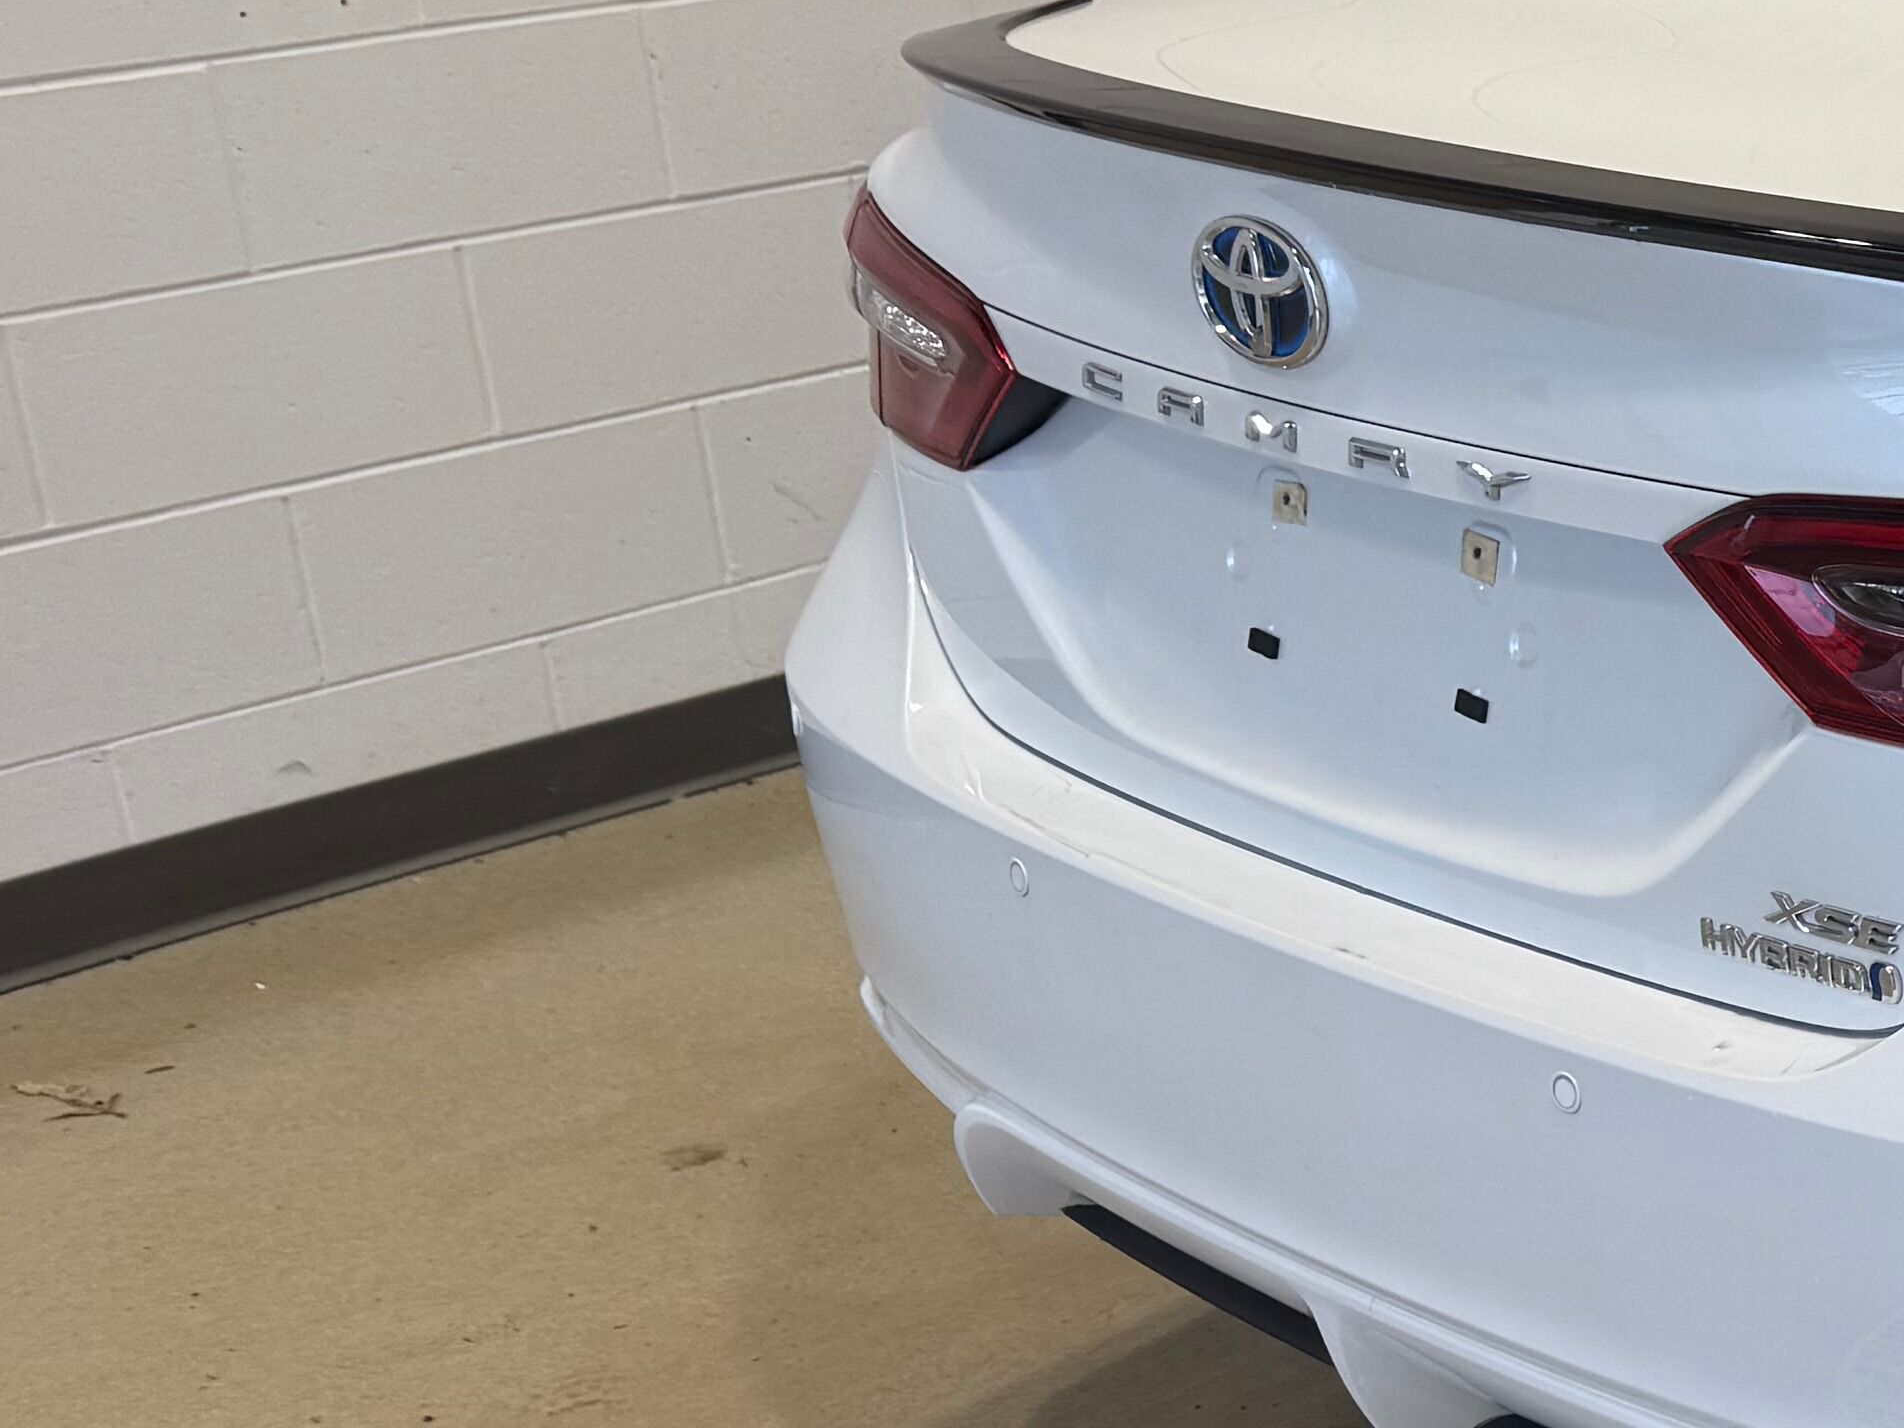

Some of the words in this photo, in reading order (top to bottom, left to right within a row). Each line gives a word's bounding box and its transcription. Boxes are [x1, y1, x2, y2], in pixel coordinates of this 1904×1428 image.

[1082, 362, 1531, 500] CAMRY
[1700, 917, 1870, 995] HYBRID
[1764, 891, 1904, 954] XSE
